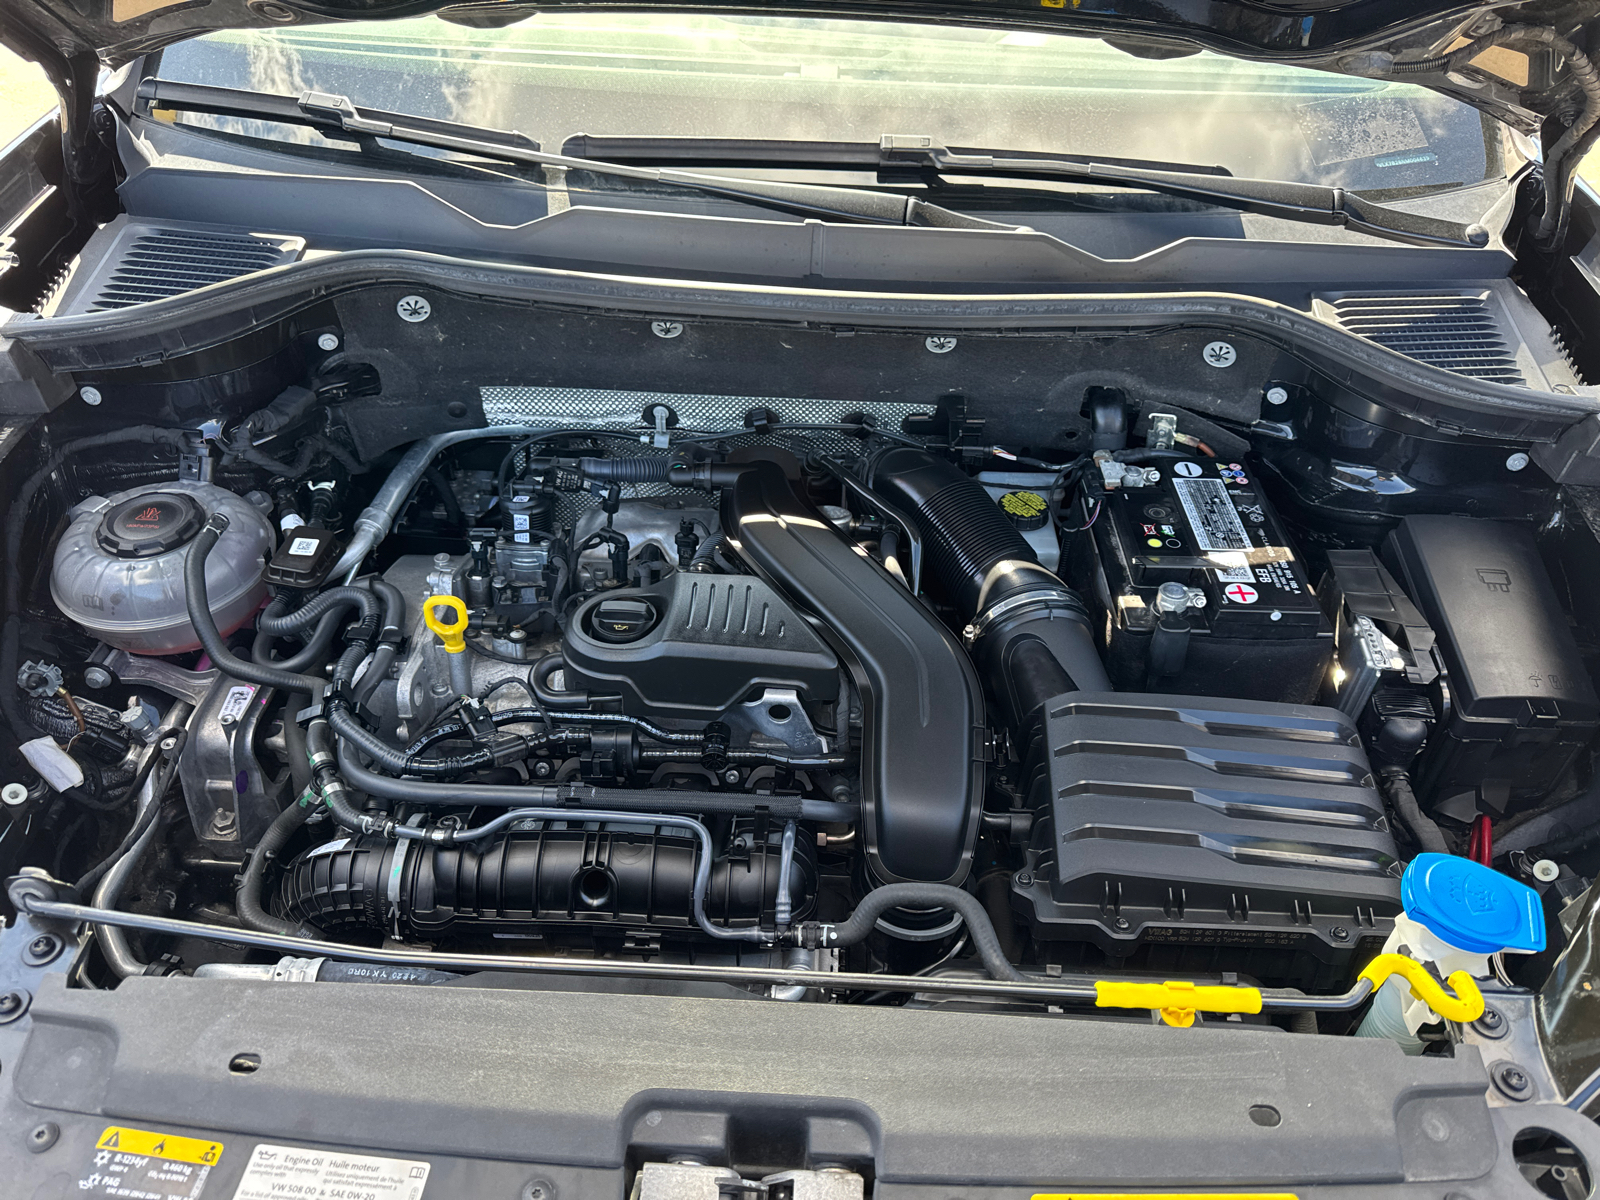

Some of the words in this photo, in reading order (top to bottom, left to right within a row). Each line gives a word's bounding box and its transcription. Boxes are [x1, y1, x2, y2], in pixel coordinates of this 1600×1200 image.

[1255, 568, 1272, 583] EFB
[113, 1153, 149, 1168] R-1234yf
[284, 1155, 310, 1166] Engine
[311, 1157, 324, 1166] Oil
[328, 1160, 349, 1169] Huile
[350, 1162, 380, 1172] moteur
[182, 1164, 193, 1176] kg
[249, 1169, 273, 1177] complies
[294, 1166, 320, 1176] expressly
[101, 1175, 121, 1187] PAG
[325, 1170, 346, 1178] Utilisez
[346, 1173, 379, 1182] uniquement
[387, 1176, 405, 1184] l'huile
[332, 1178, 354, 1186] satisfait
[354, 1180, 393, 1191] expressément
[271, 1183, 287, 1192] VW
[287, 1184, 304, 1194] 508
[304, 1186, 317, 1195] 00
[329, 1189, 346, 1198] SAE
[346, 1191, 376, 1200] 0W-20
